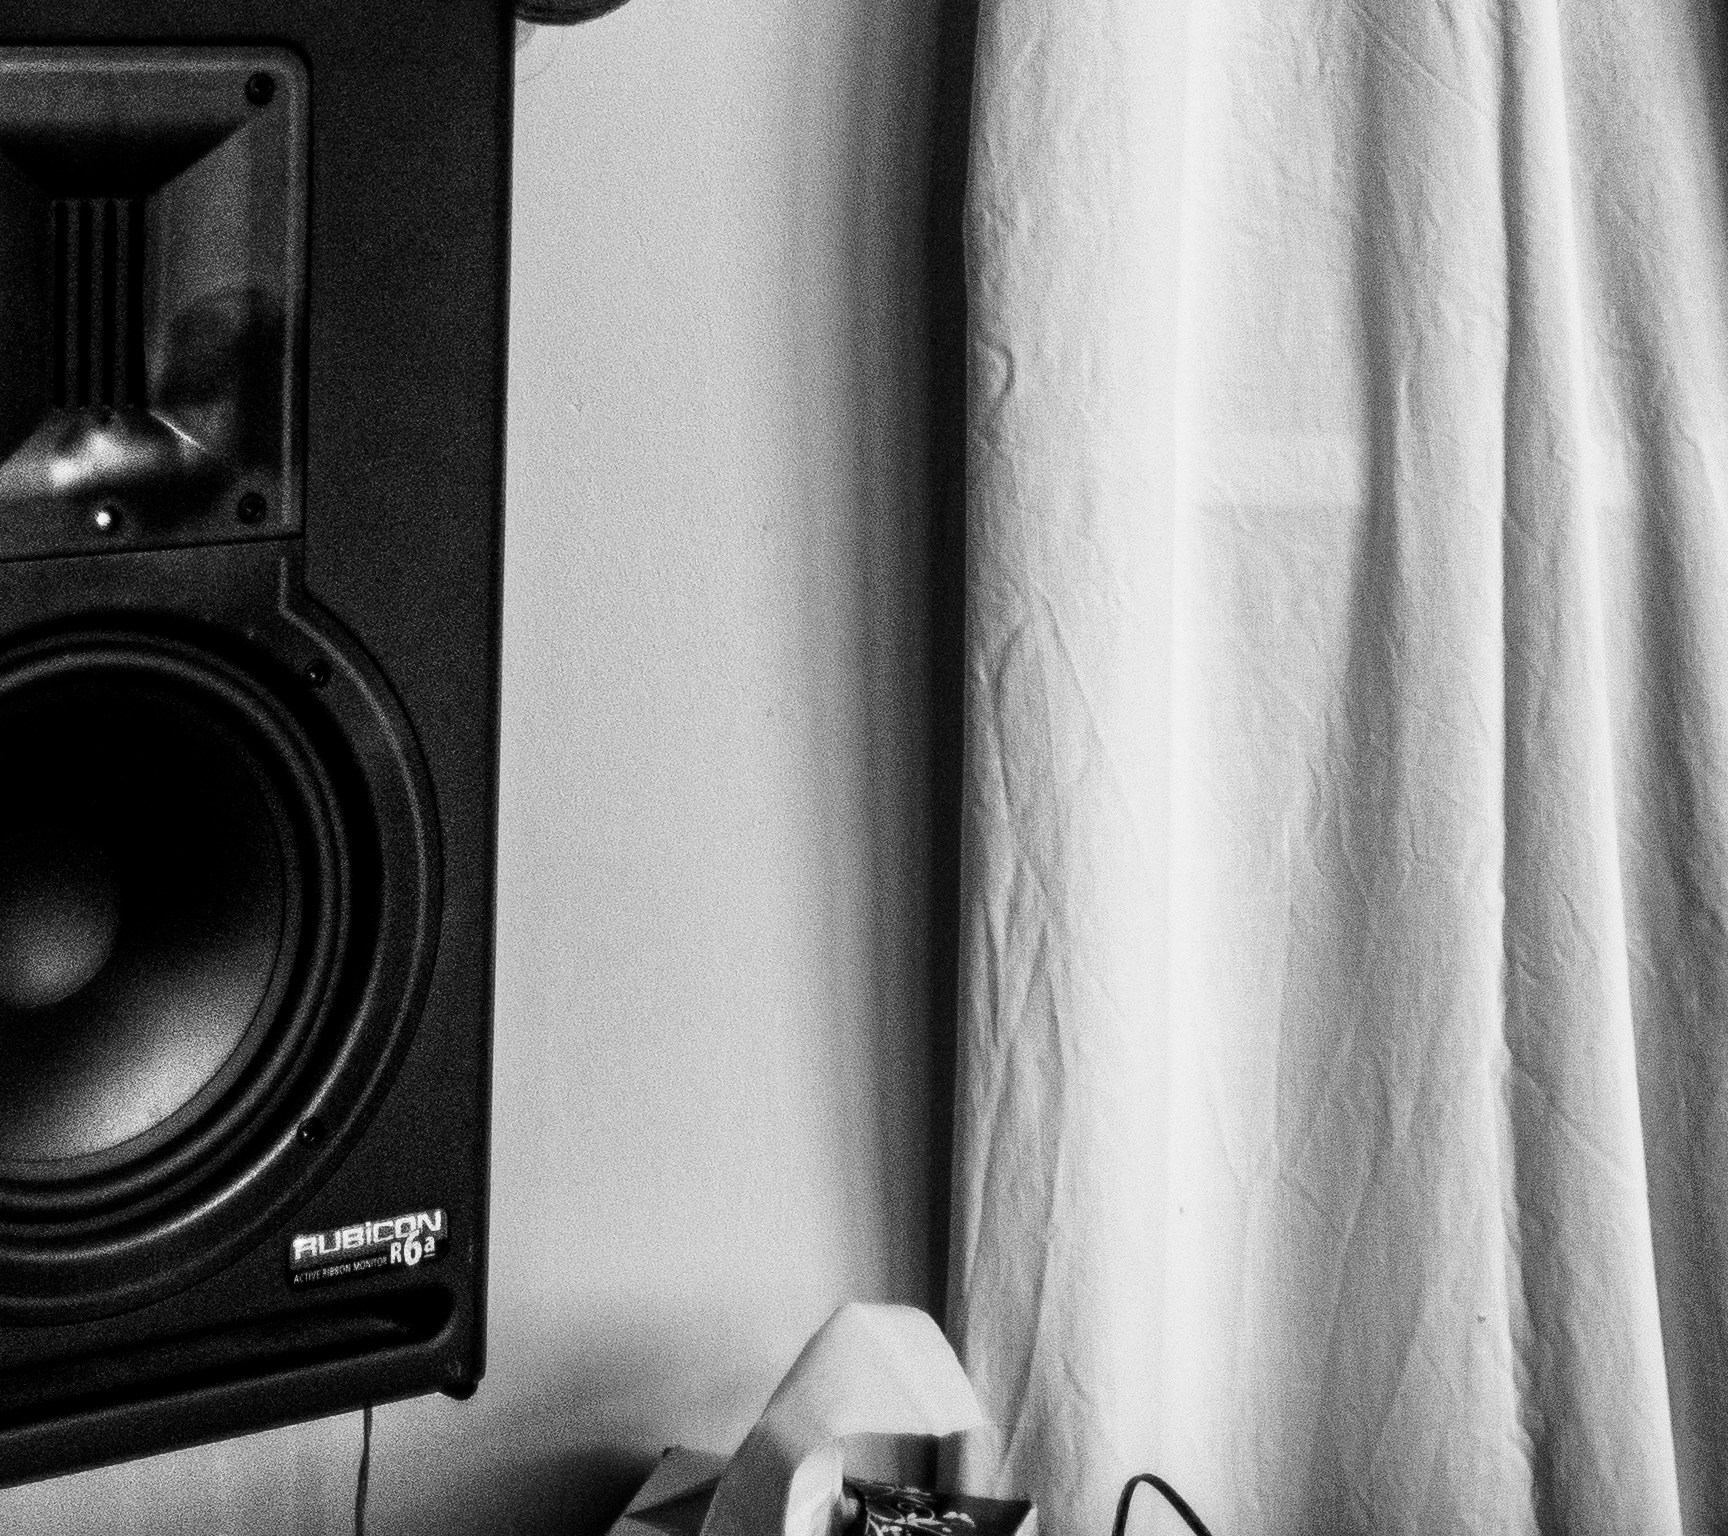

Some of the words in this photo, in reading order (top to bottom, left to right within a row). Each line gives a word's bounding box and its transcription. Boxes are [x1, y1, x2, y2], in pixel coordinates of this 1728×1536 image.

[294, 1270, 320, 1284] ACTIVE
[323, 1263, 351, 1278] RIBBON
[353, 1256, 387, 1271] MONITOR
[390, 1229, 435, 1266] R6a
